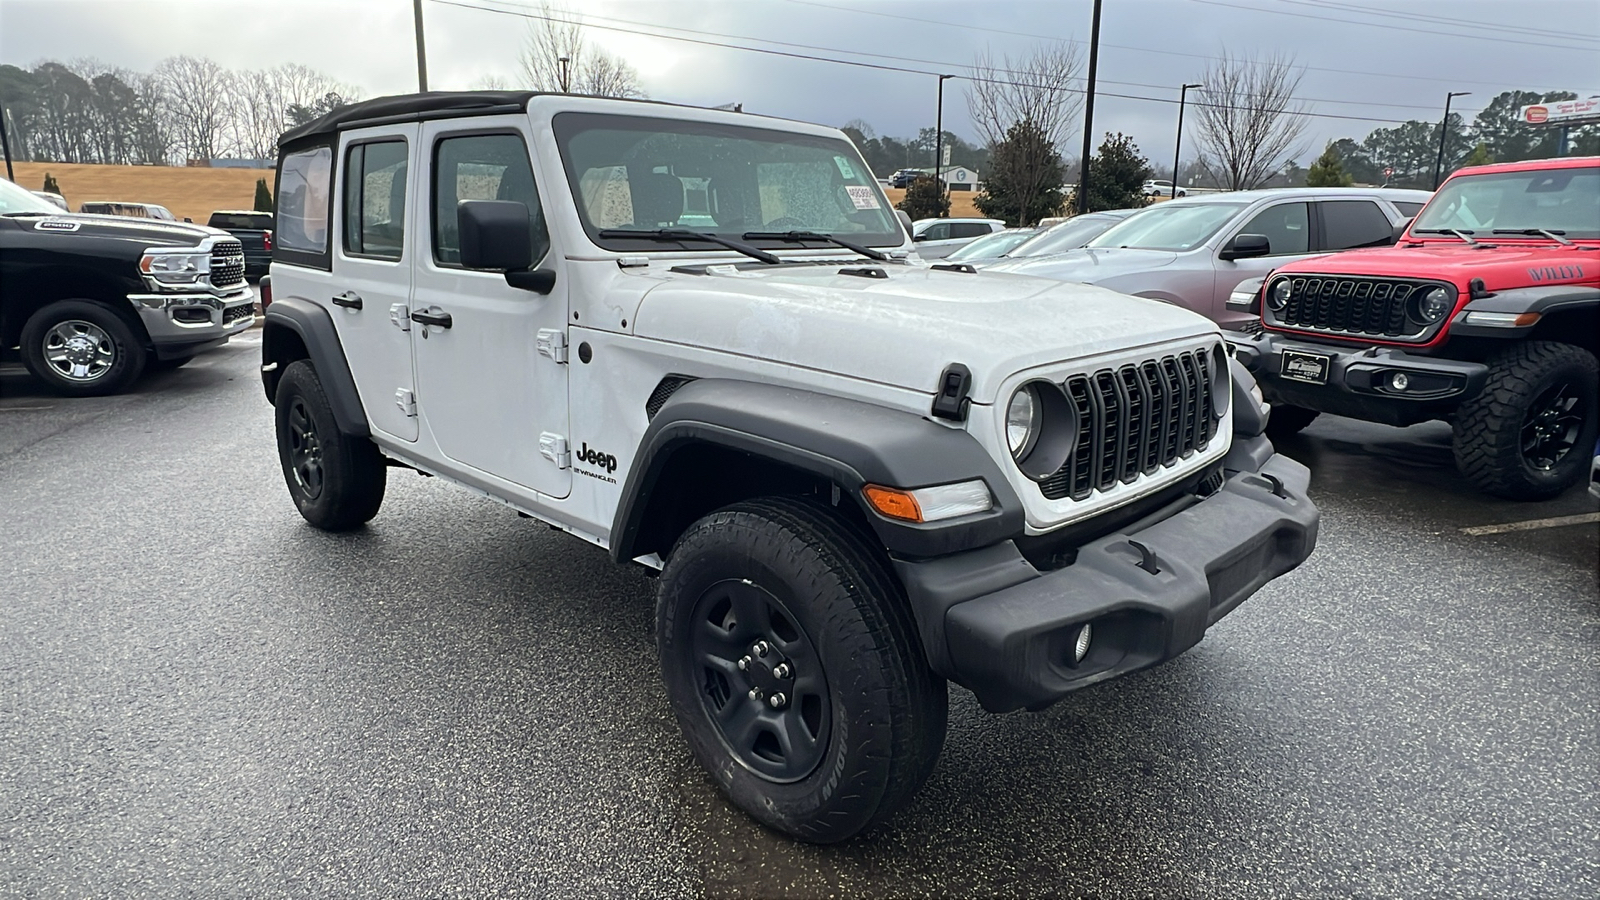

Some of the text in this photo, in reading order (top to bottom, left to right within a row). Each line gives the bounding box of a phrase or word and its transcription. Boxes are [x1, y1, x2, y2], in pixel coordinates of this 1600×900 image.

[1528, 265, 1584, 281] WILLYS
[576, 441, 618, 475] Jeep
[580, 468, 617, 485] WRANGLER
